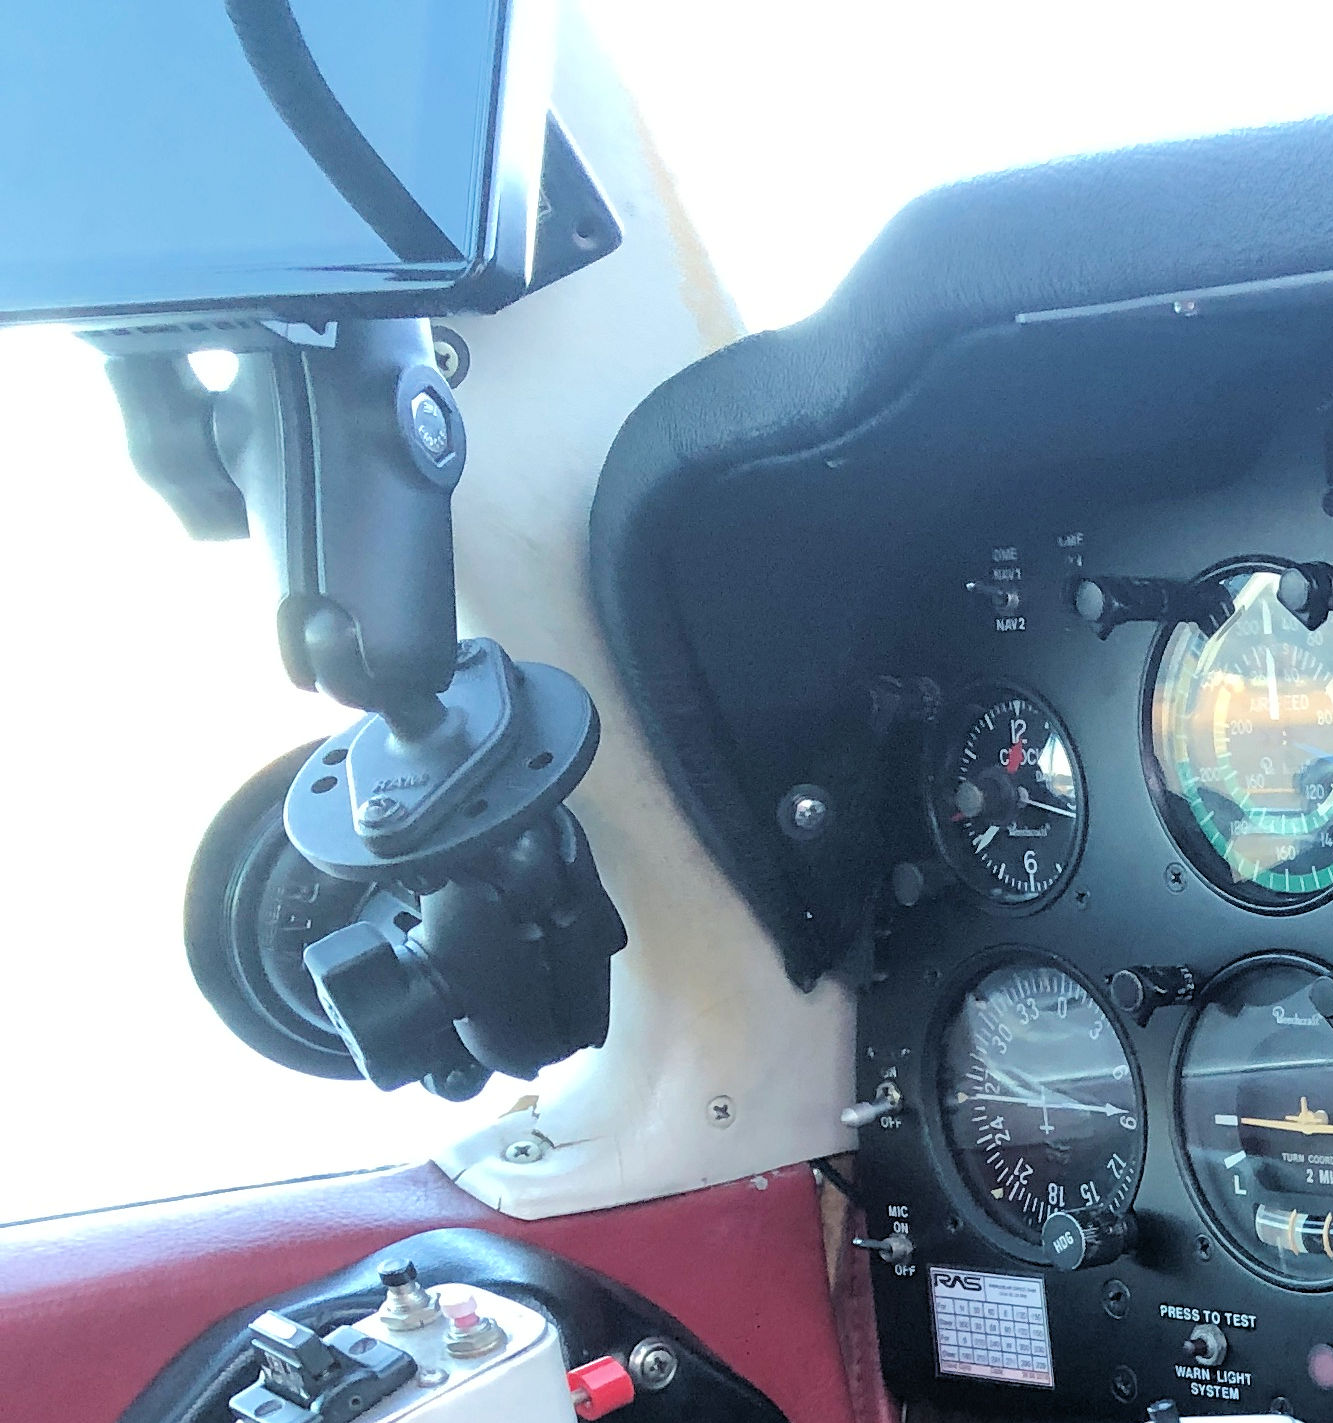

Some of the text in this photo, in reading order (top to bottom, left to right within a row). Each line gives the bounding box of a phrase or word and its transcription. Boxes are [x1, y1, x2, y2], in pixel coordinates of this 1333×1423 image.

[888, 1206, 909, 1219] MIC
[893, 1221, 909, 1234] ON
[1053, 1231, 1074, 1255] HDG
[894, 1264, 916, 1277] OFF
[933, 1273, 982, 1291] RAS
[1160, 1305, 1257, 1328] PRESS TO TEST
[1175, 1365, 1252, 1386] WARN LIGHT
[1191, 1382, 1240, 1400] SYSTEM
